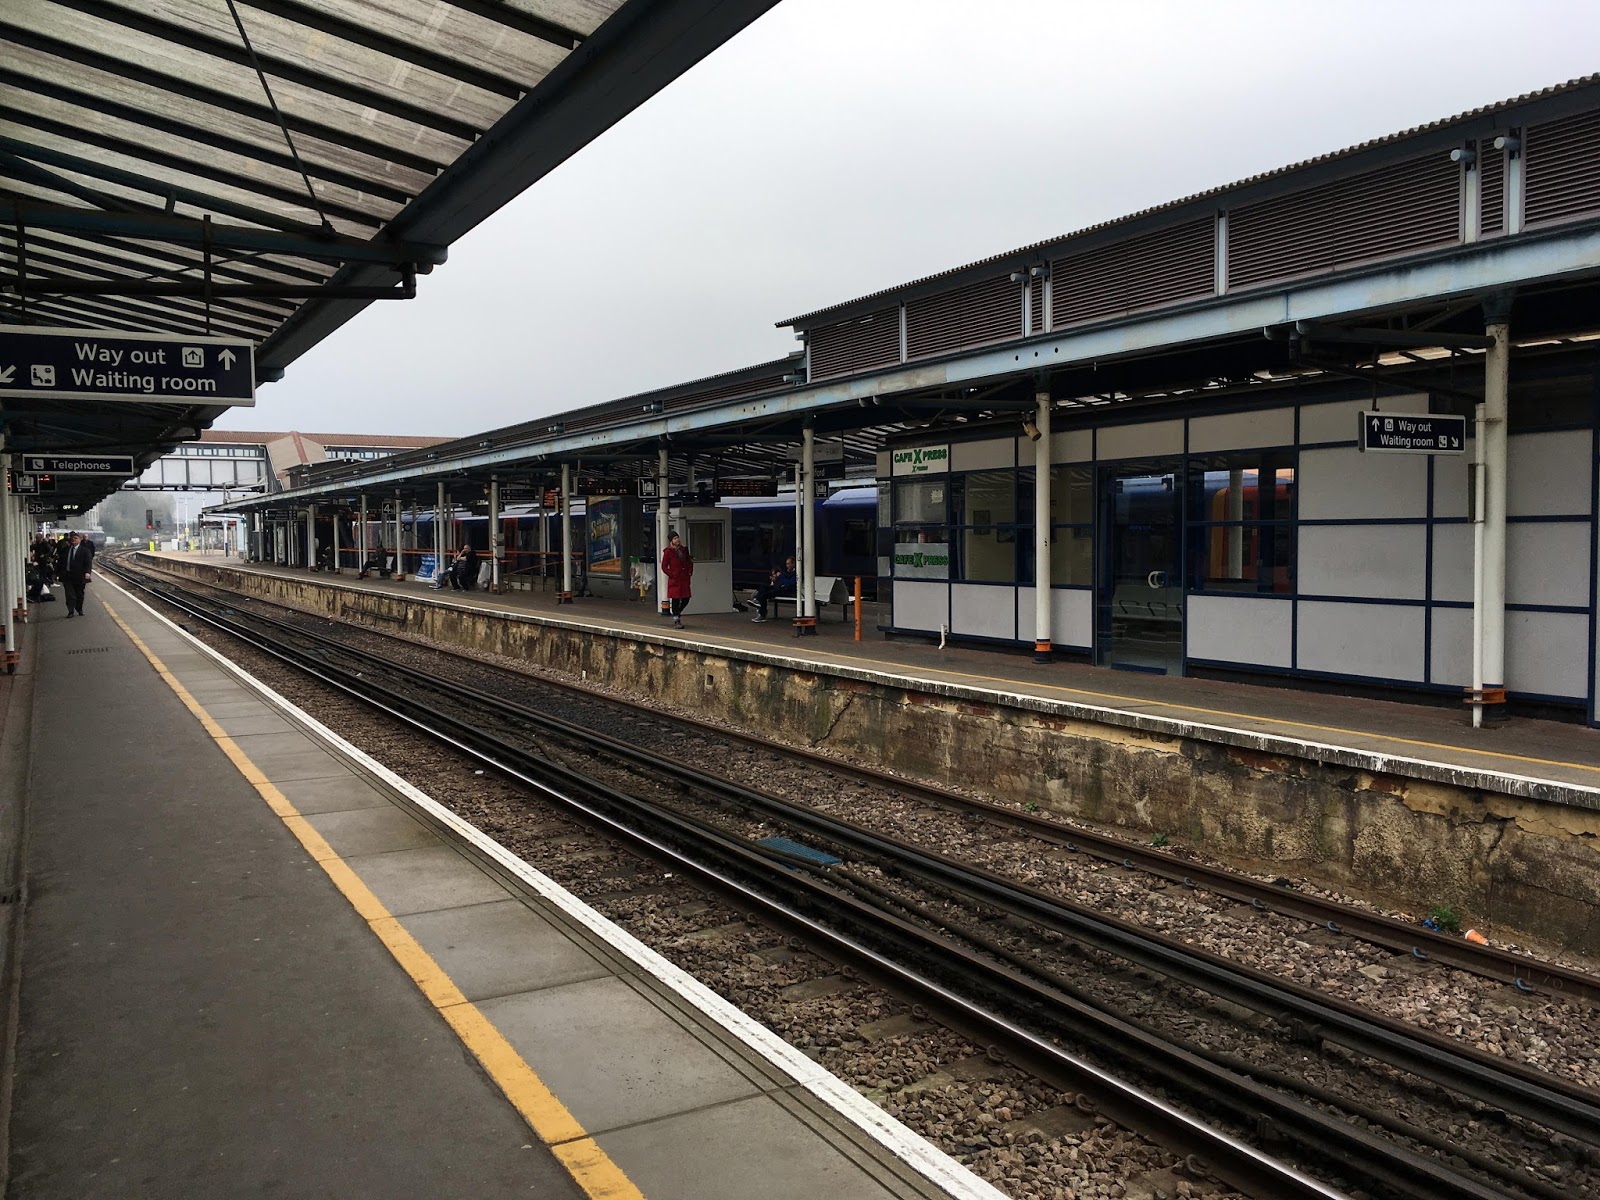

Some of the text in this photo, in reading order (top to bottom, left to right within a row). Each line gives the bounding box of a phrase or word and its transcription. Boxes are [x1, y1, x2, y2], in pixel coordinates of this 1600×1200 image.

[75, 342, 166, 366] Way out
[71, 368, 217, 393] Waiting room
[1398, 420, 1432, 434] Way out
[1380, 433, 1434, 448] Waiting room
[894, 452, 913, 463] CAFE
[51, 460, 111, 471] Telephones
[29, 505, 42, 513] 5b
[894, 554, 913, 564] CAFE
